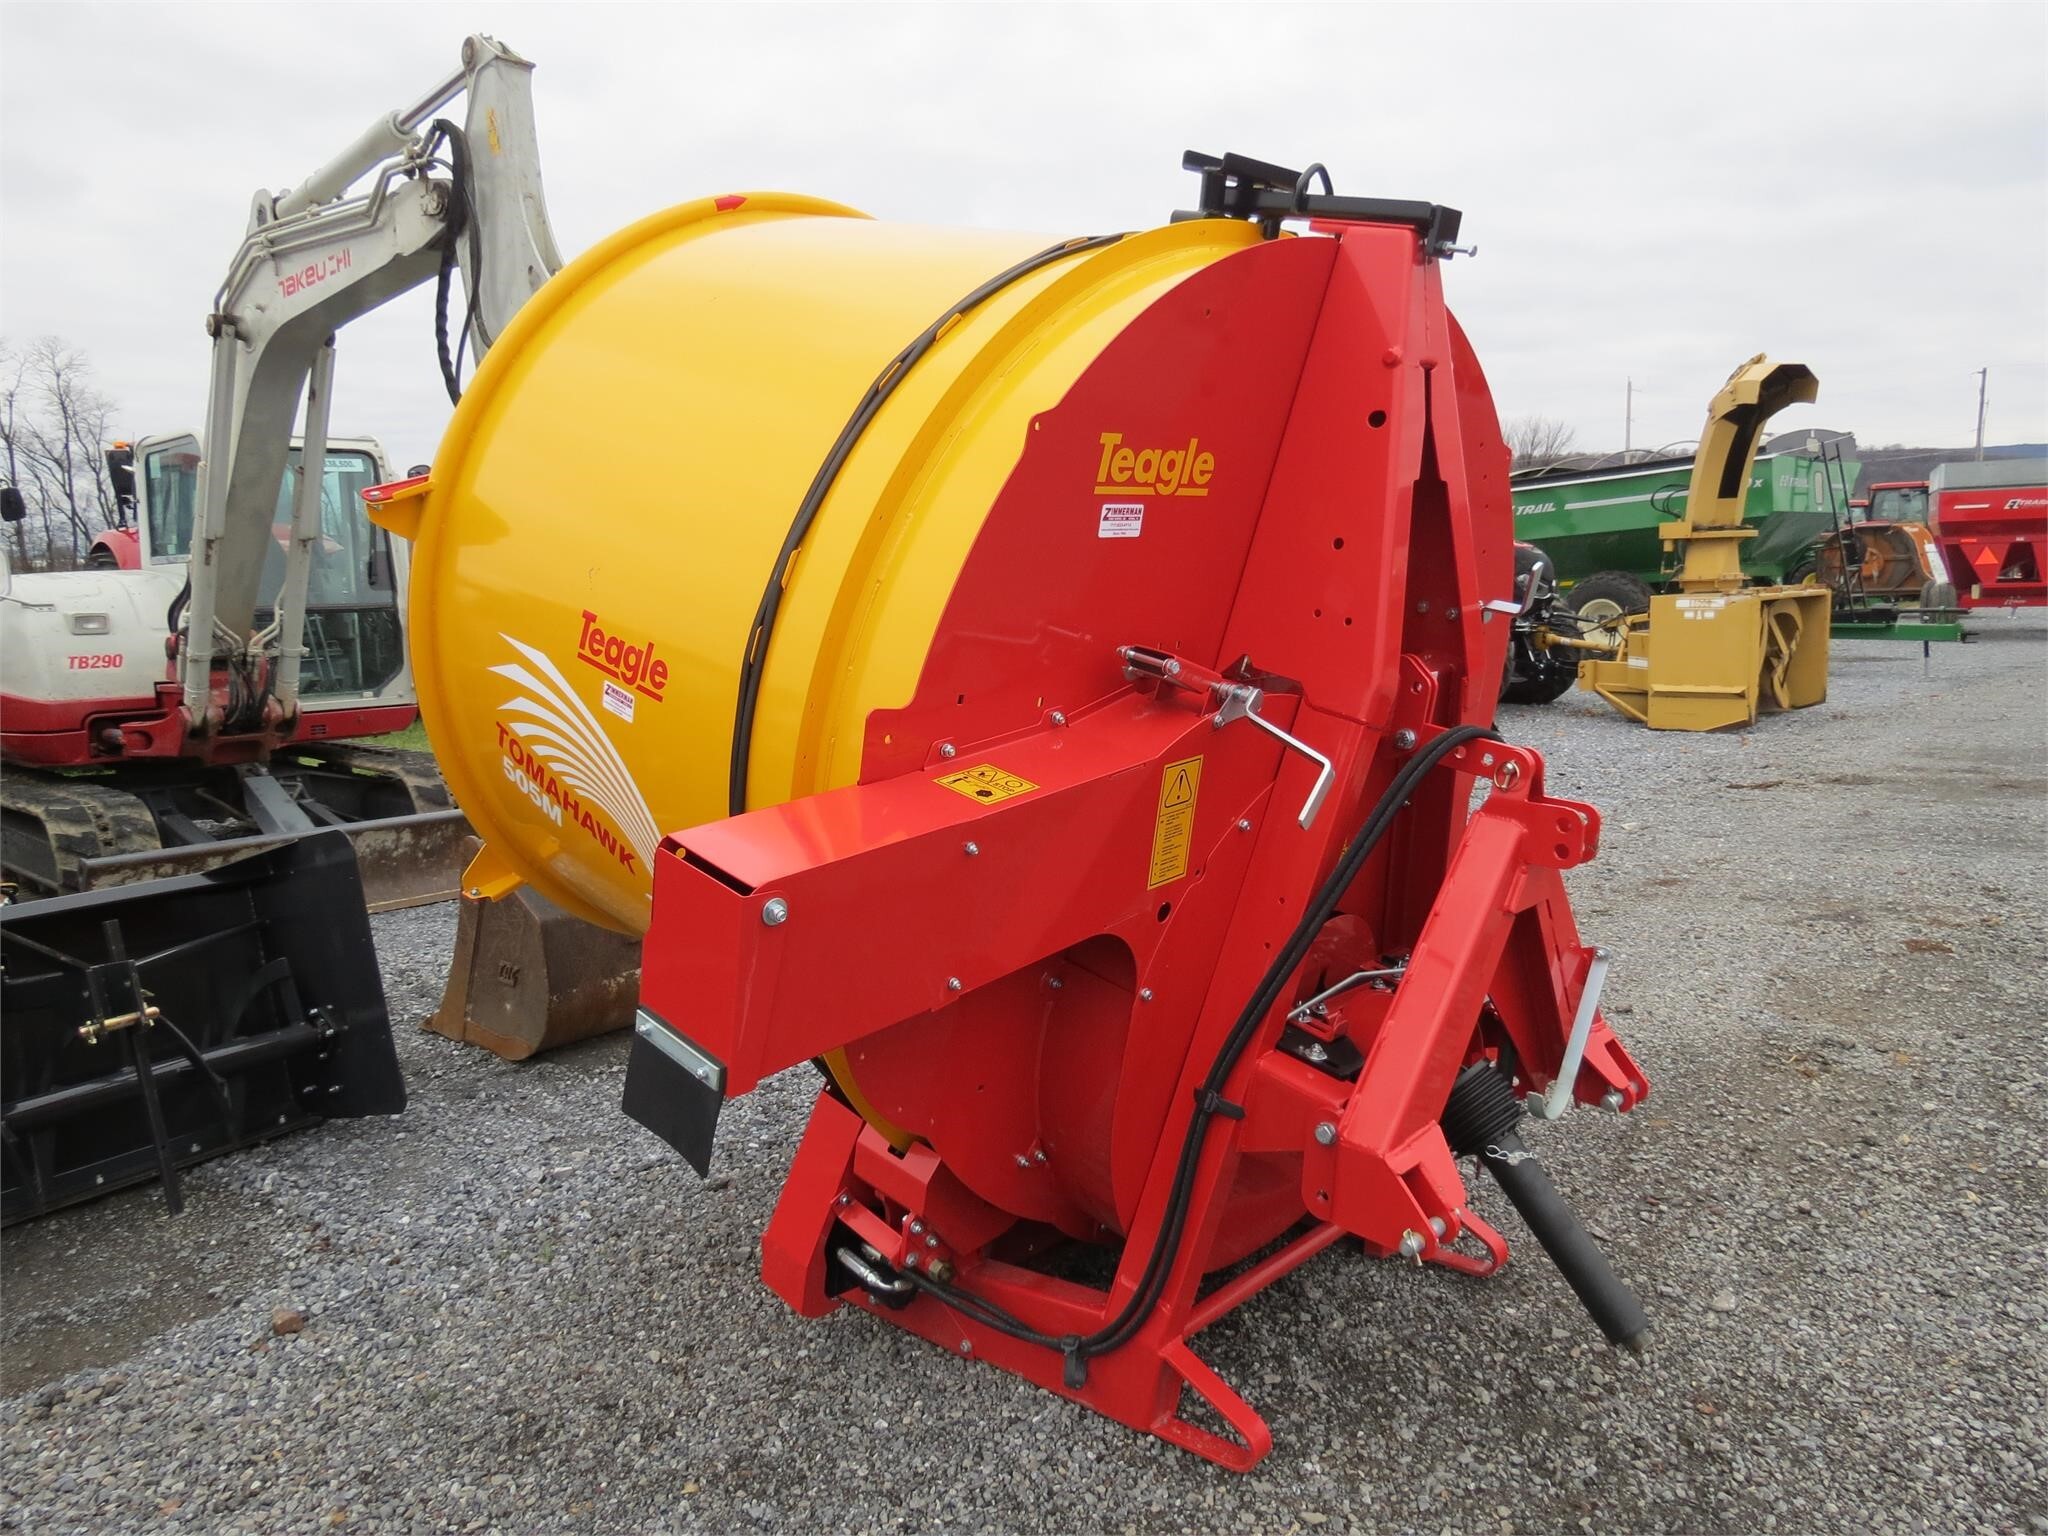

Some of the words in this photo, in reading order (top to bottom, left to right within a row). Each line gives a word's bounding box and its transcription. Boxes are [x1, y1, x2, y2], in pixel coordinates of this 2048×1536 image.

[1096, 432, 1215, 495] Teagle
[68, 654, 123, 669] TB290
[579, 609, 668, 690] Teagle
[496, 721, 636, 875] TOMAHAWK
[503, 755, 562, 828] 505M
